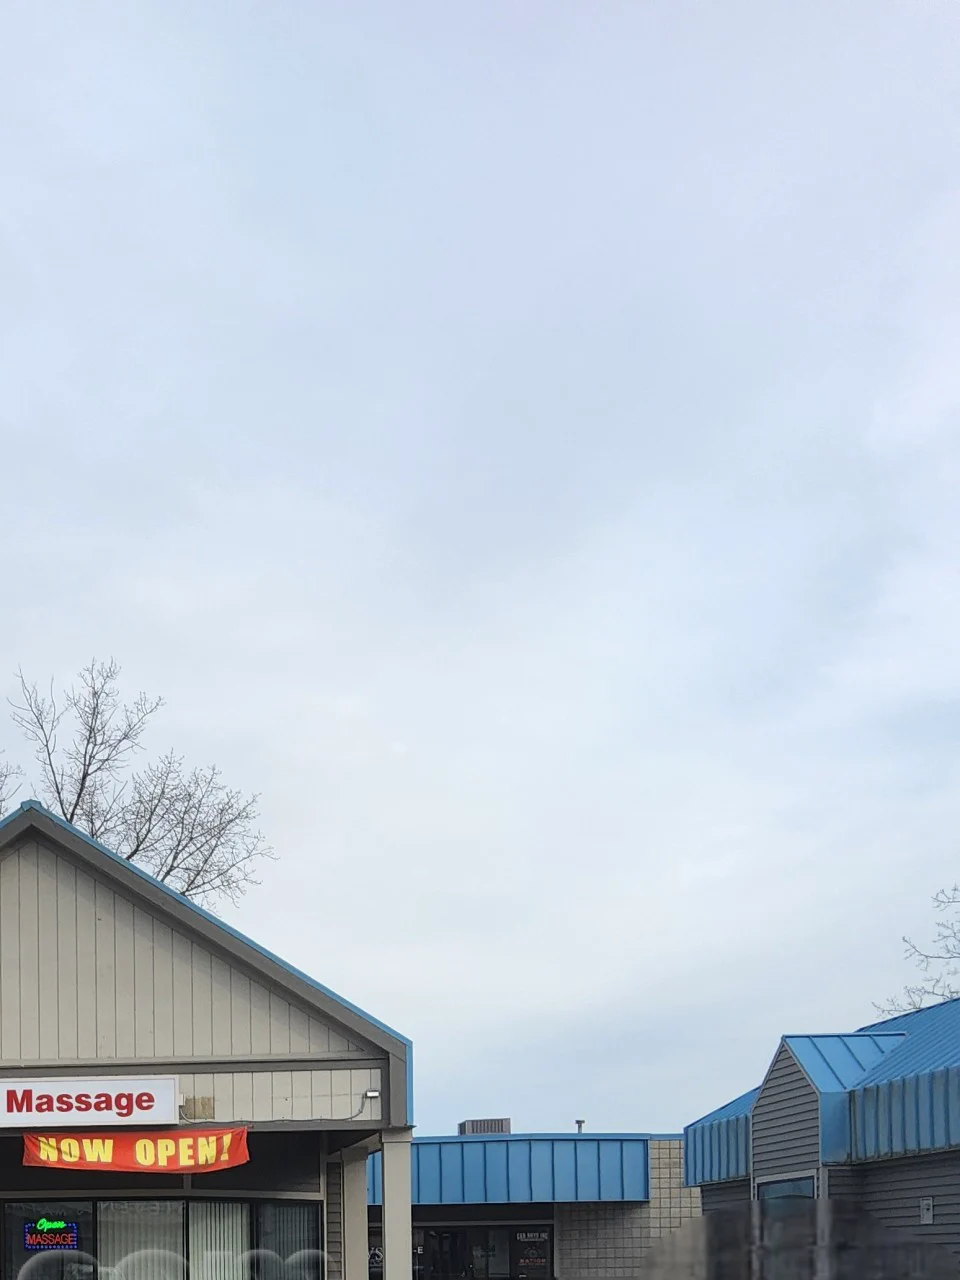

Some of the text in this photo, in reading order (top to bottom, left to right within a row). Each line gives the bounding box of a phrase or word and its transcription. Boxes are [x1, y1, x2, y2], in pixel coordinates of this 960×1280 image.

[6, 1089, 156, 1118] Massage
[39, 1132, 233, 1167] NOW OPEN!
[36, 1217, 66, 1232] Open
[26, 1233, 77, 1245] MASSAGE
